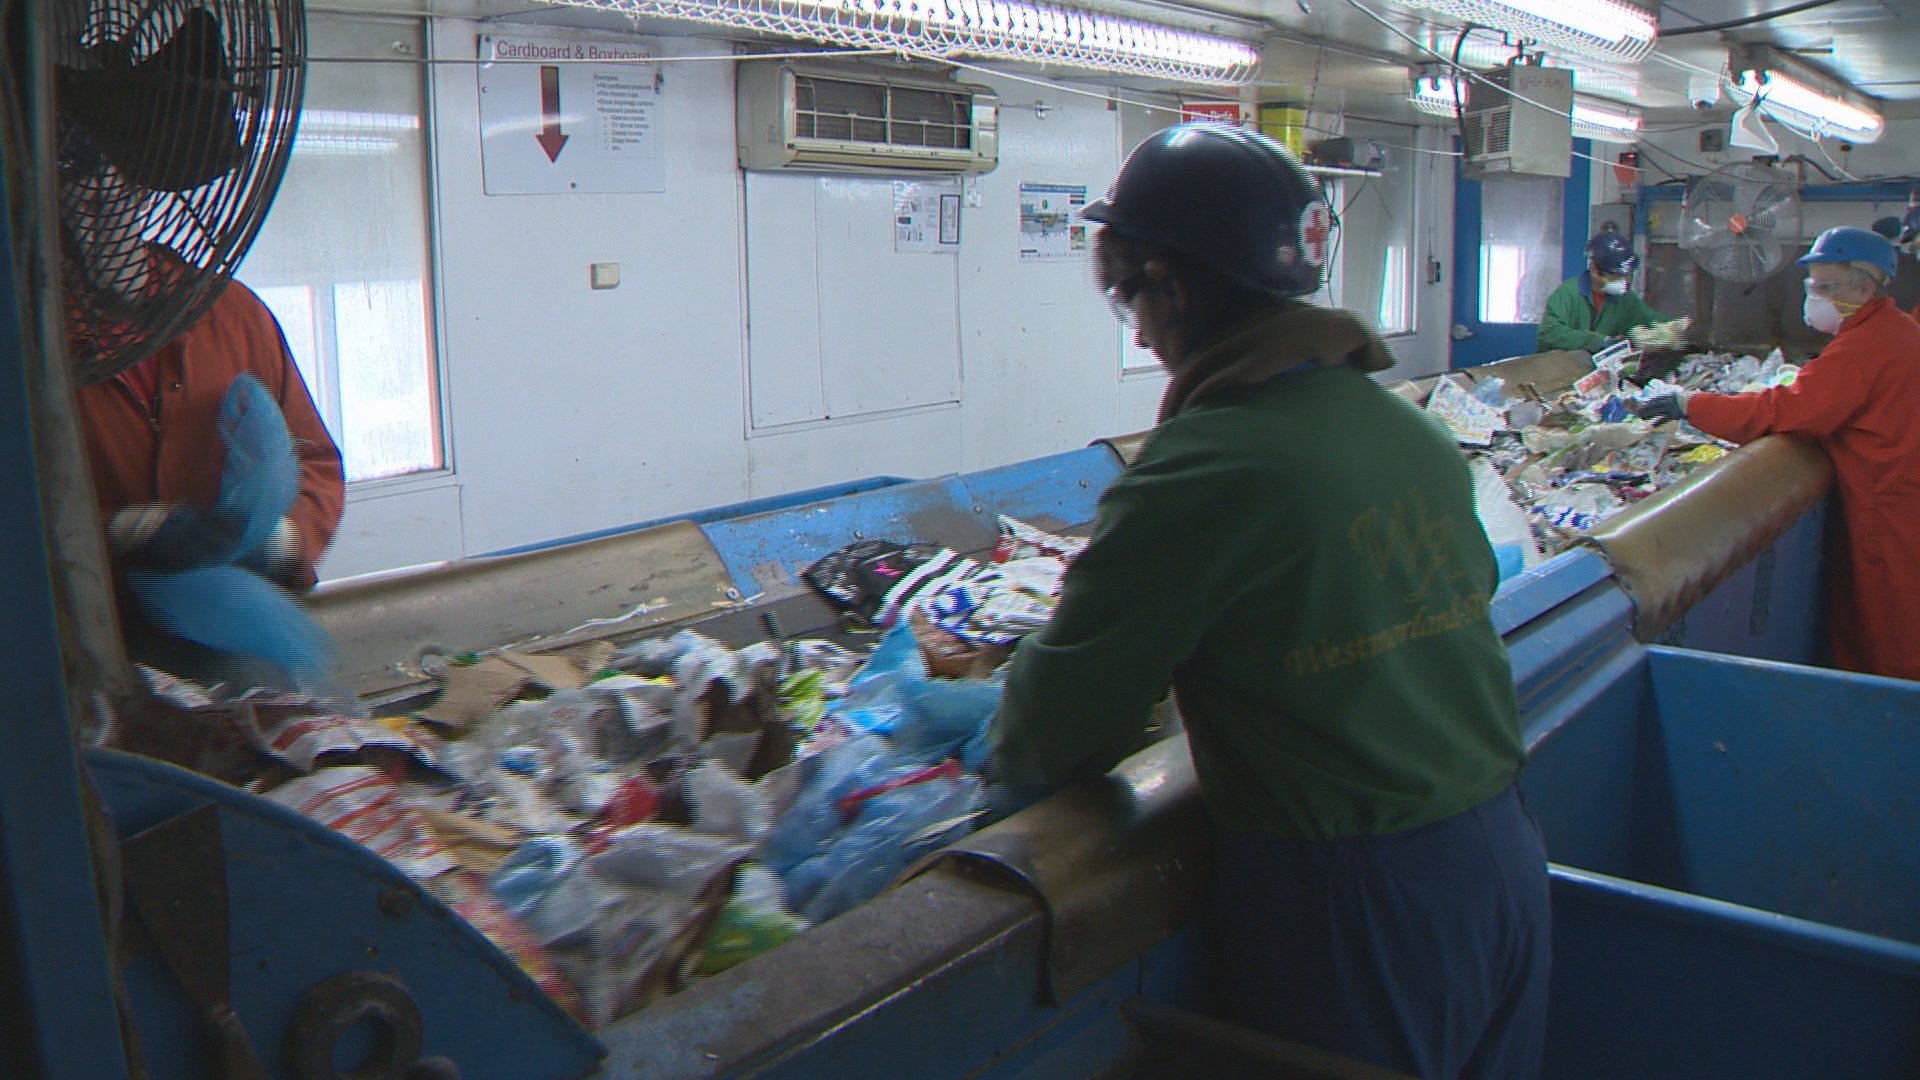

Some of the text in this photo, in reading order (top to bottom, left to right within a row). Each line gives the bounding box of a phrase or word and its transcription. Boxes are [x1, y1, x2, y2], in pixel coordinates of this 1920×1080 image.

[497, 40, 650, 62] Cardboard & Boxboard
